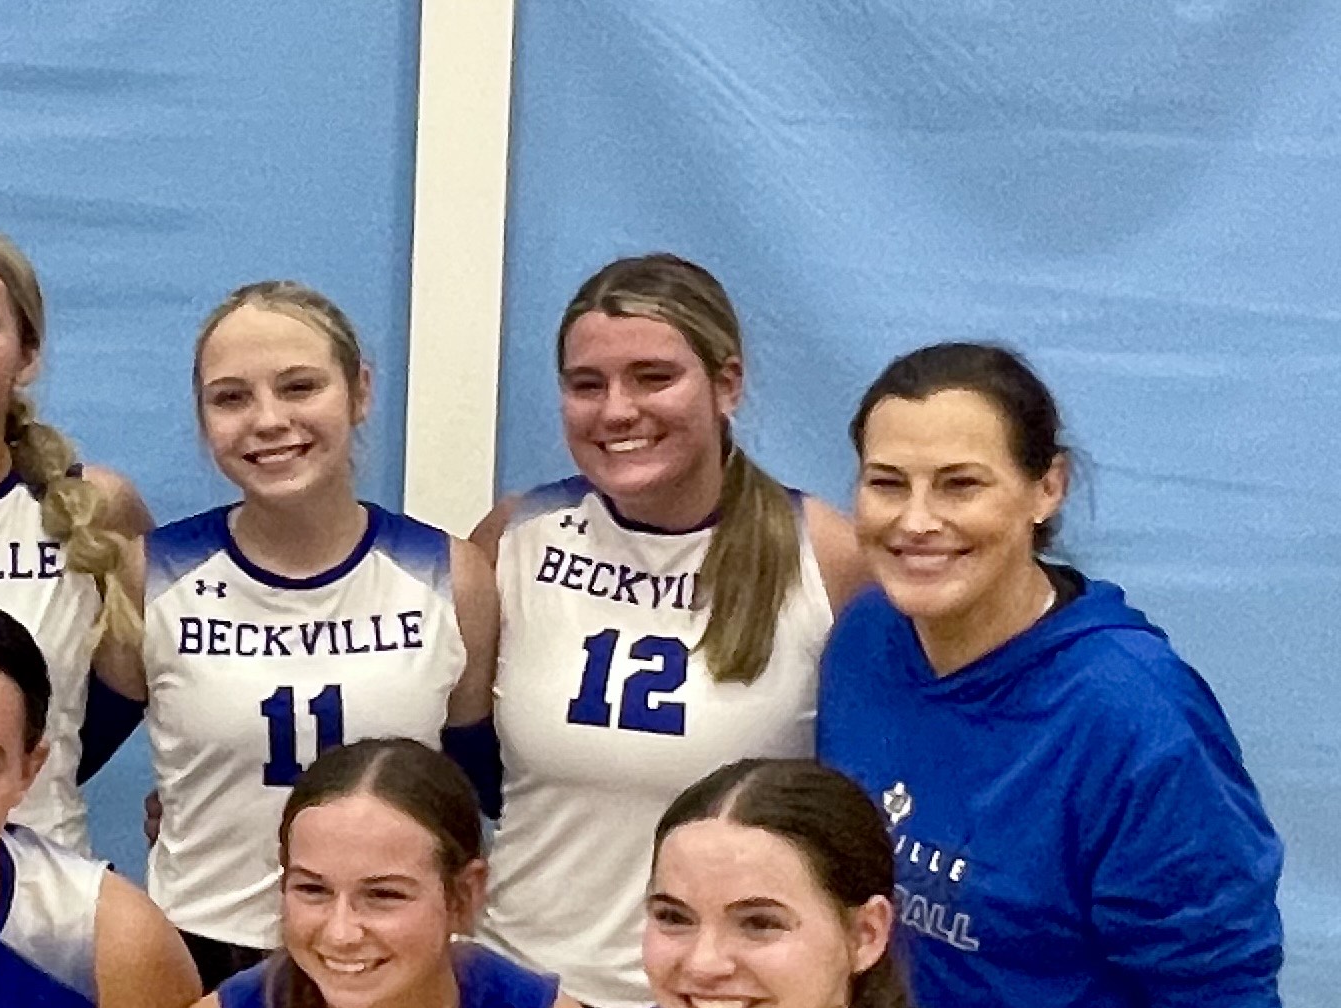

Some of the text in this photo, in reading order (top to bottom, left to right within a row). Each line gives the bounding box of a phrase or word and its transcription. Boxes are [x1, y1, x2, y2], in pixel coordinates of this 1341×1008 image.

[178, 611, 422, 656] BECKVILLE
[567, 628, 690, 736] 12
[260, 684, 343, 786] 11
